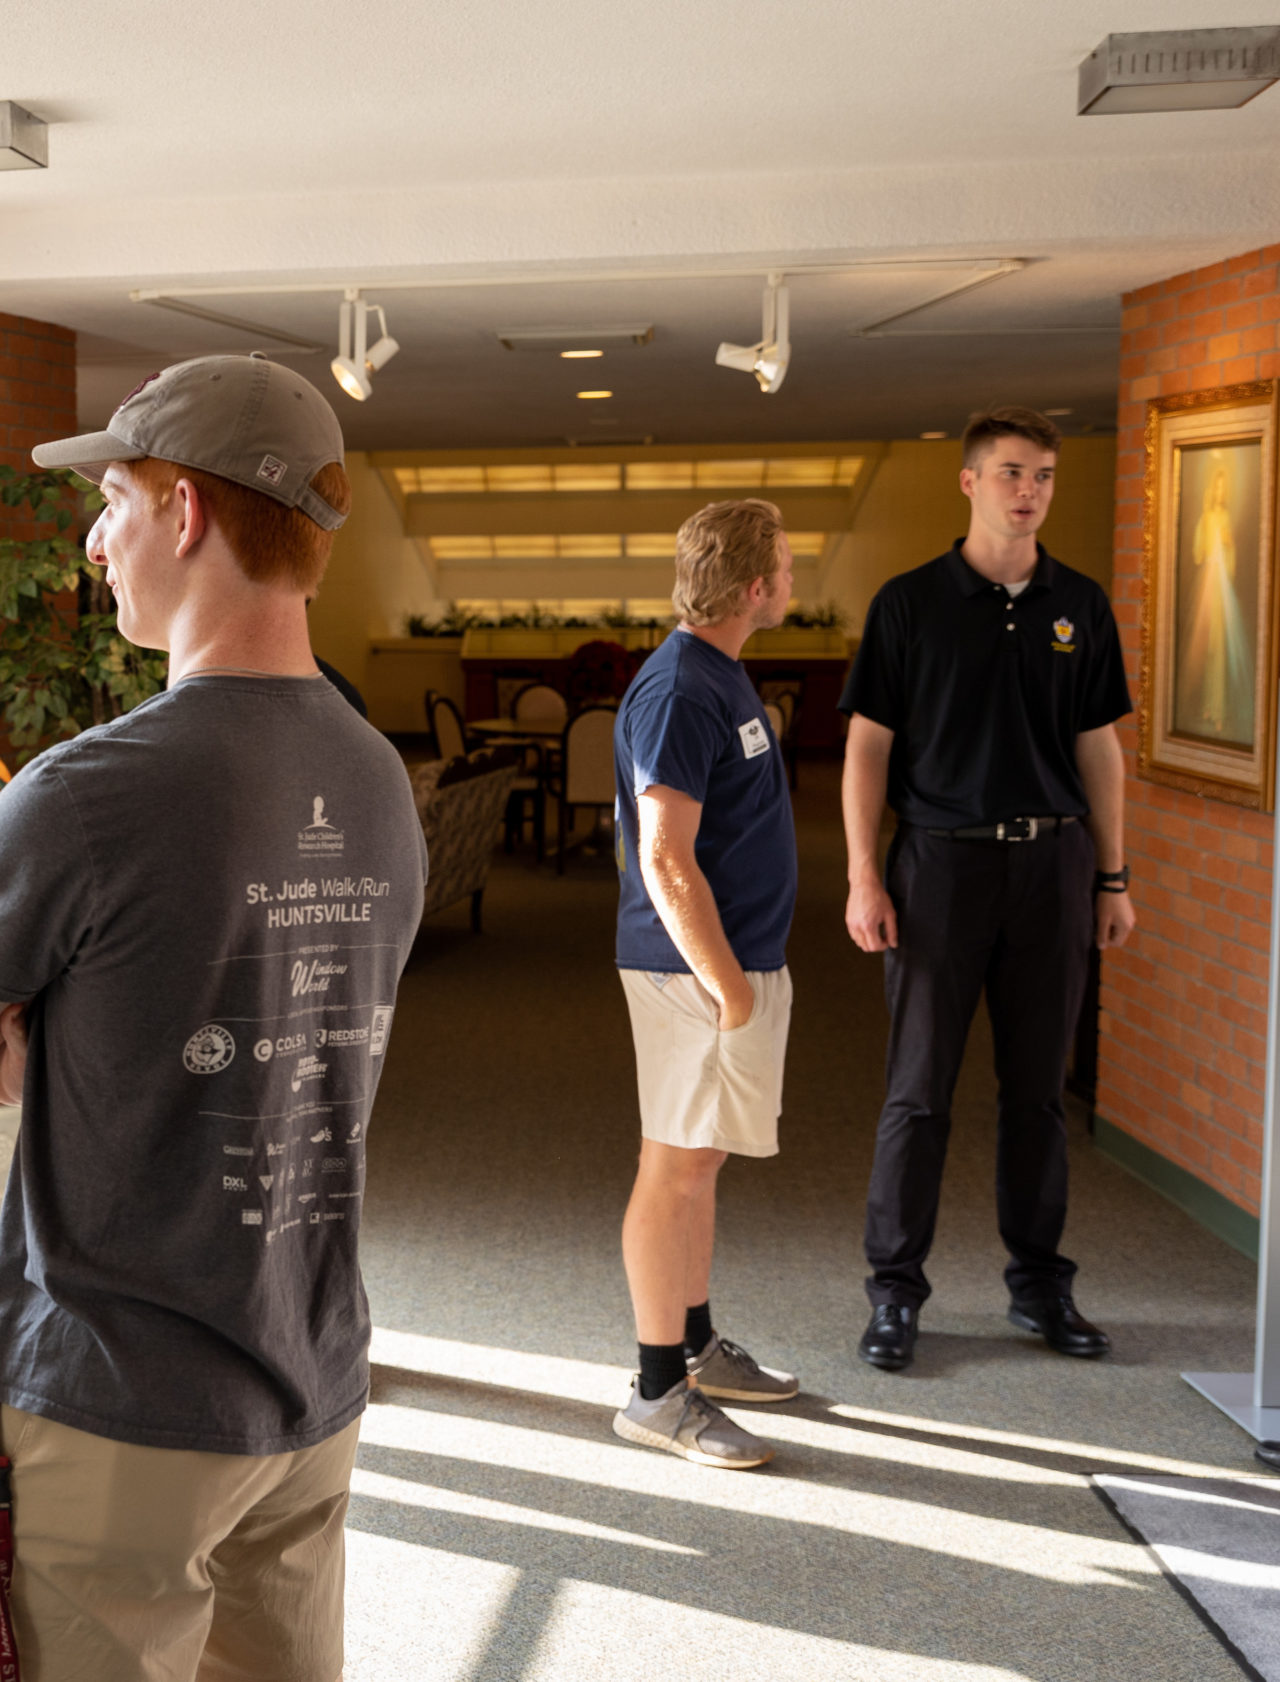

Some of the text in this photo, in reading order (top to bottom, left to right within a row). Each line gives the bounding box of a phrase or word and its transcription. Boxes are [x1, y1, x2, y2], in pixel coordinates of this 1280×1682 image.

[246, 877, 390, 904] St. Jude Walk/Run
[267, 903, 372, 929] HUNTSVILLE
[290, 959, 348, 995] Window
[328, 1028, 369, 1041] REDSTOE
[223, 1175, 248, 1188] DXL
